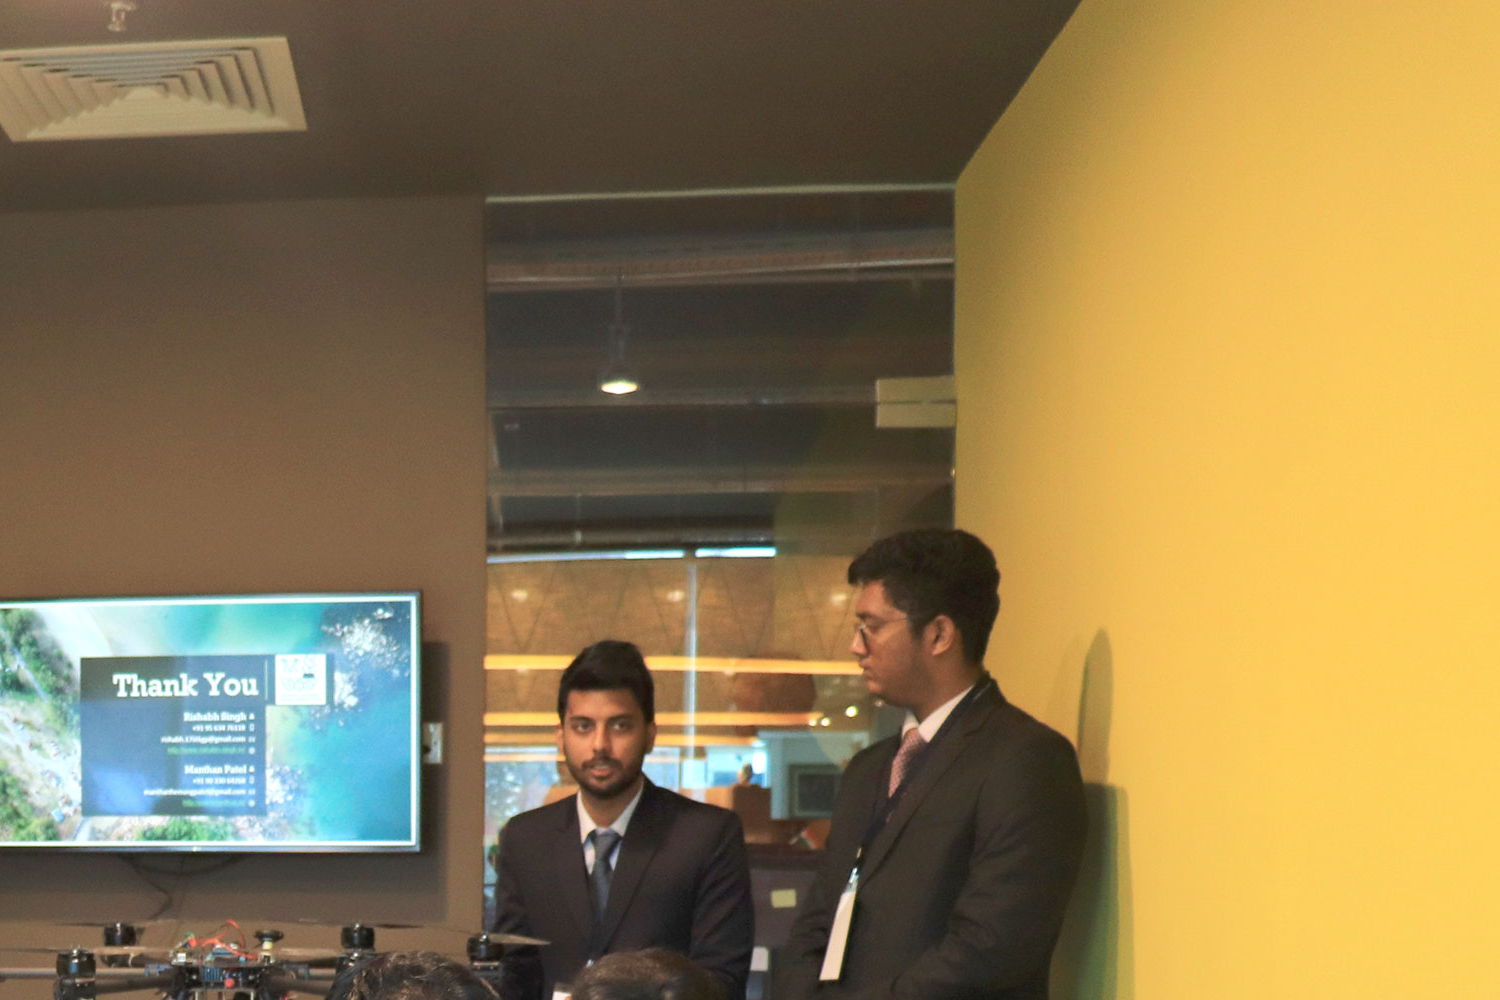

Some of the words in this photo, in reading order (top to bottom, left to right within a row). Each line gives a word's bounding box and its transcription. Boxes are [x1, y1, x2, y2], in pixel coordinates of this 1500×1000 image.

[112, 673, 198, 697] Thank
[203, 672, 259, 696] You
[183, 711, 220, 721] Rishabh
[221, 711, 247, 722] Singh
[184, 765, 223, 774] Manthan
[225, 764, 247, 774] Patel
